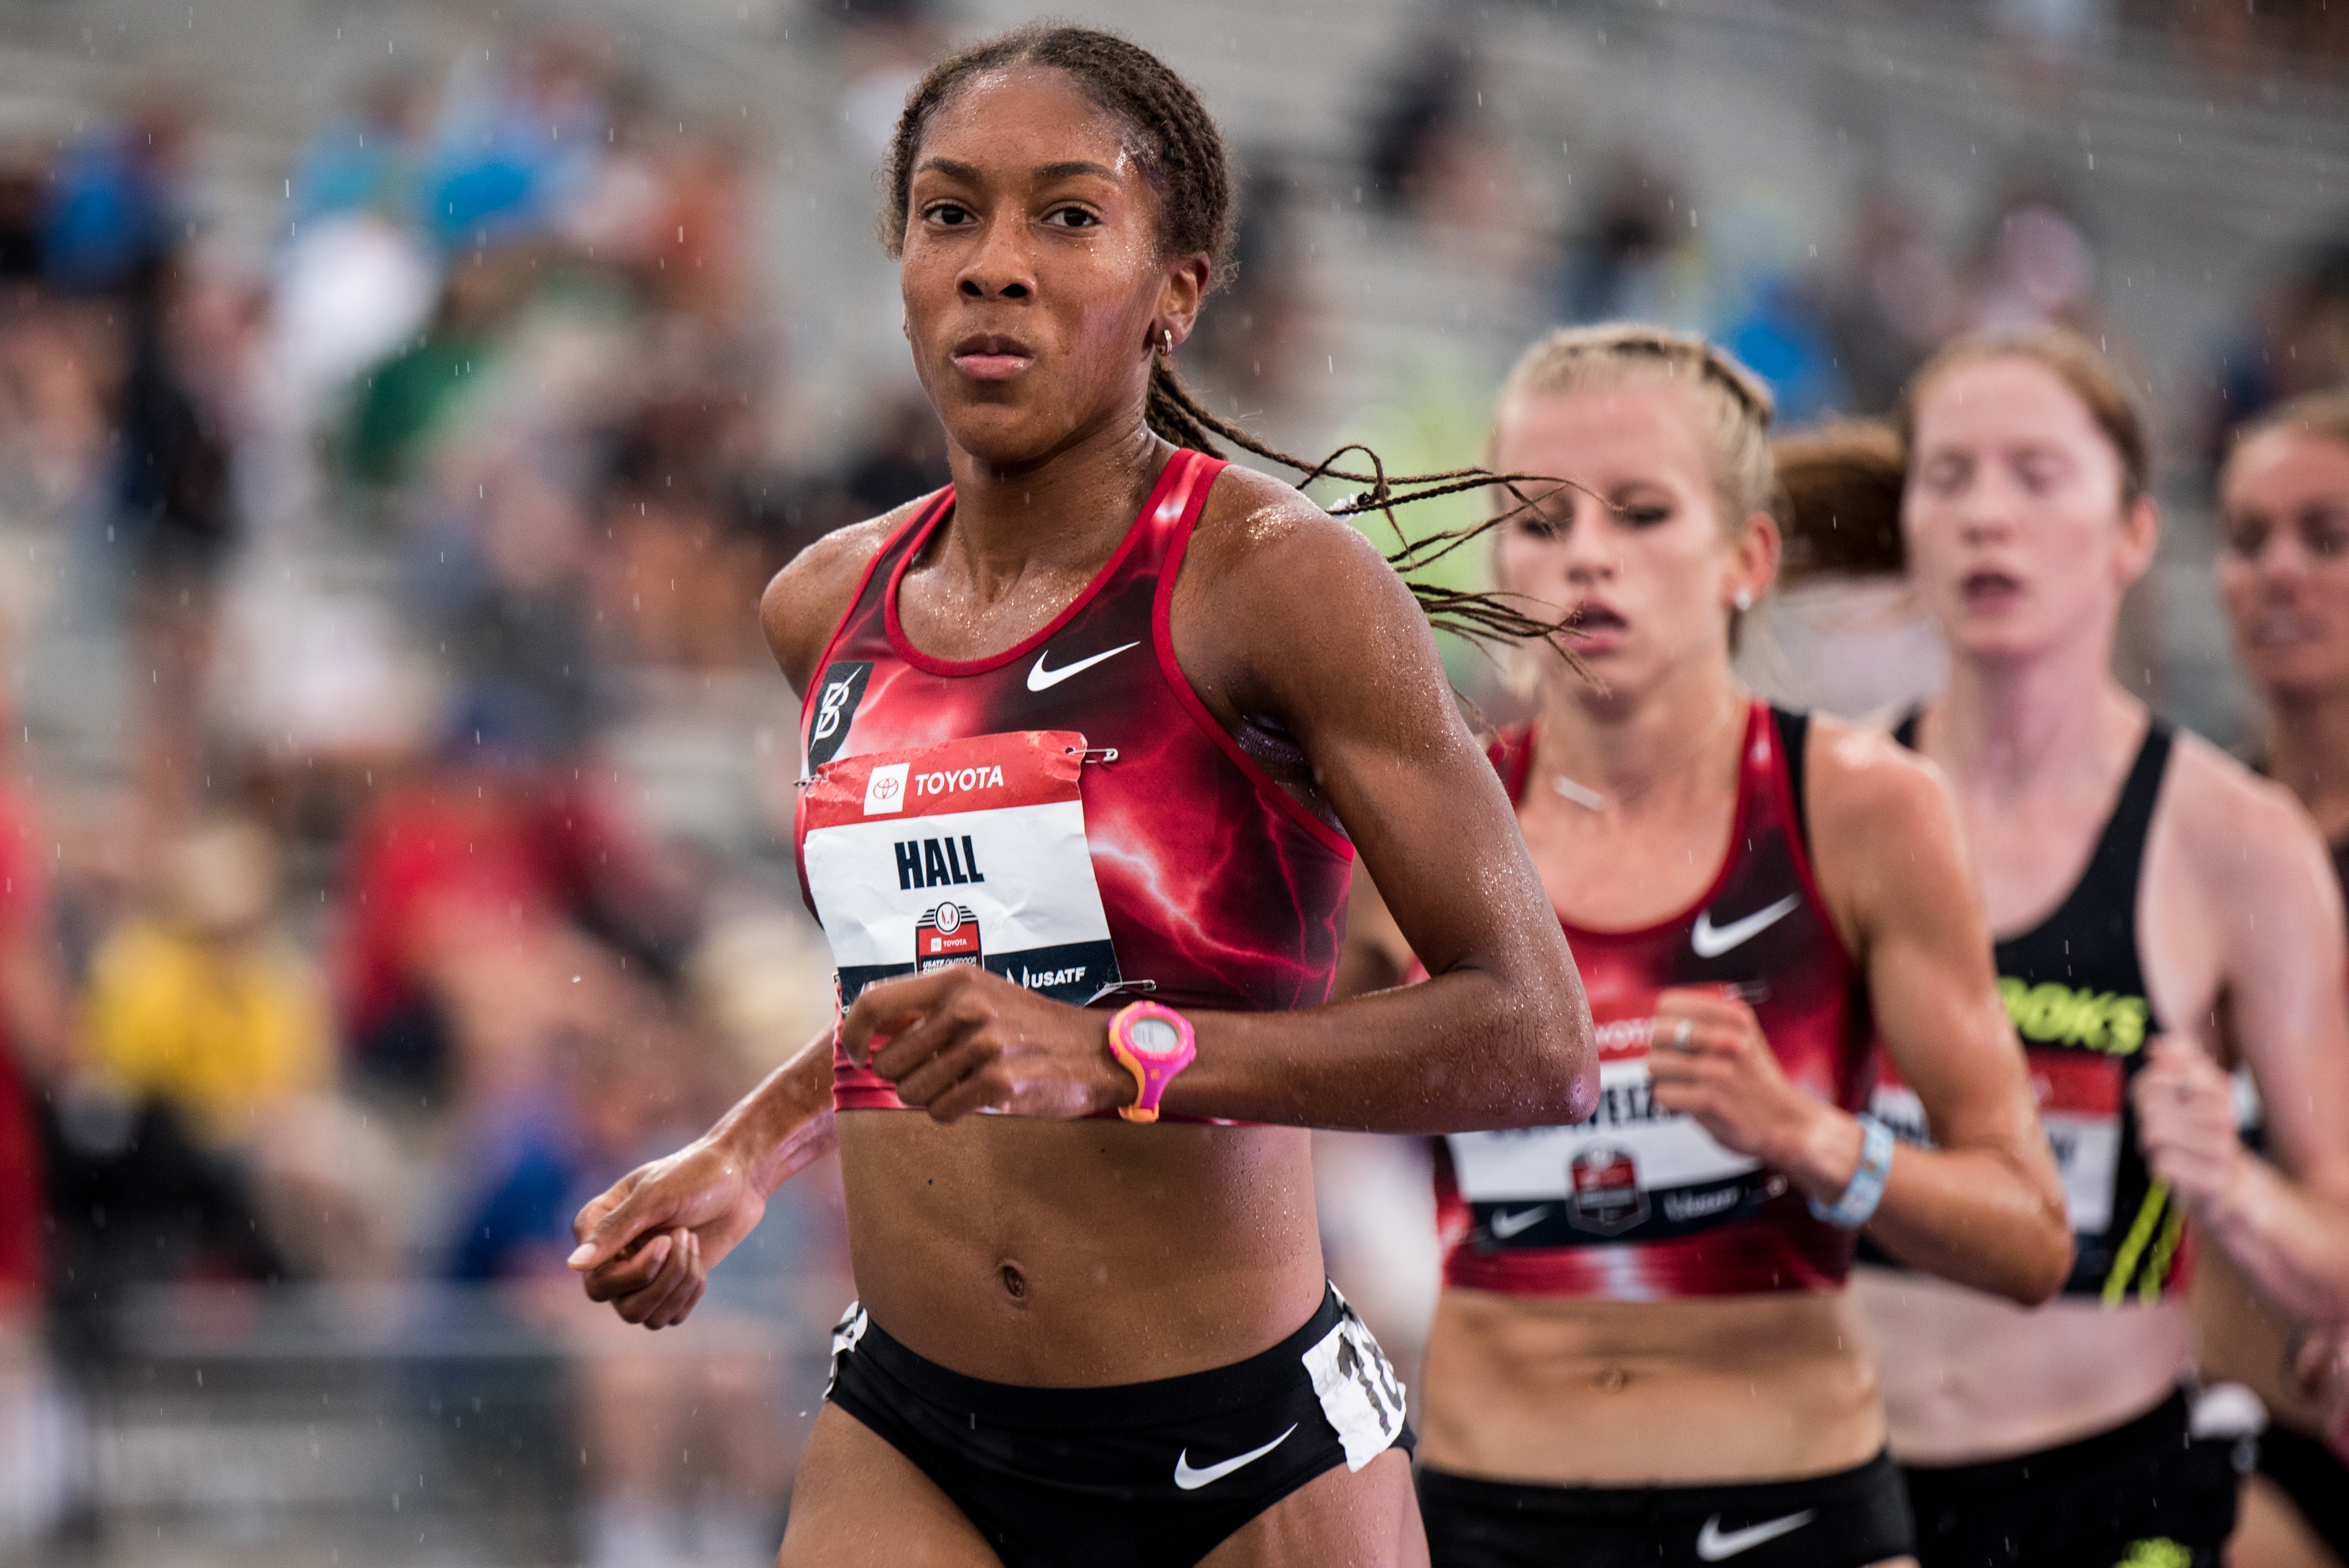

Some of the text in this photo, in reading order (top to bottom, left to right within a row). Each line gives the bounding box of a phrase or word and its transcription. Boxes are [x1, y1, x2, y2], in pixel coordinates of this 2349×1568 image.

[915, 765, 1004, 796] TOYOTA
[894, 835, 985, 891] HALL
[943, 938, 967, 948] TOYOTA
[923, 956, 977, 969] USATF OUTDOOR
[1031, 966, 1086, 989] USATF
[1998, 975, 2149, 1057] OOKS
